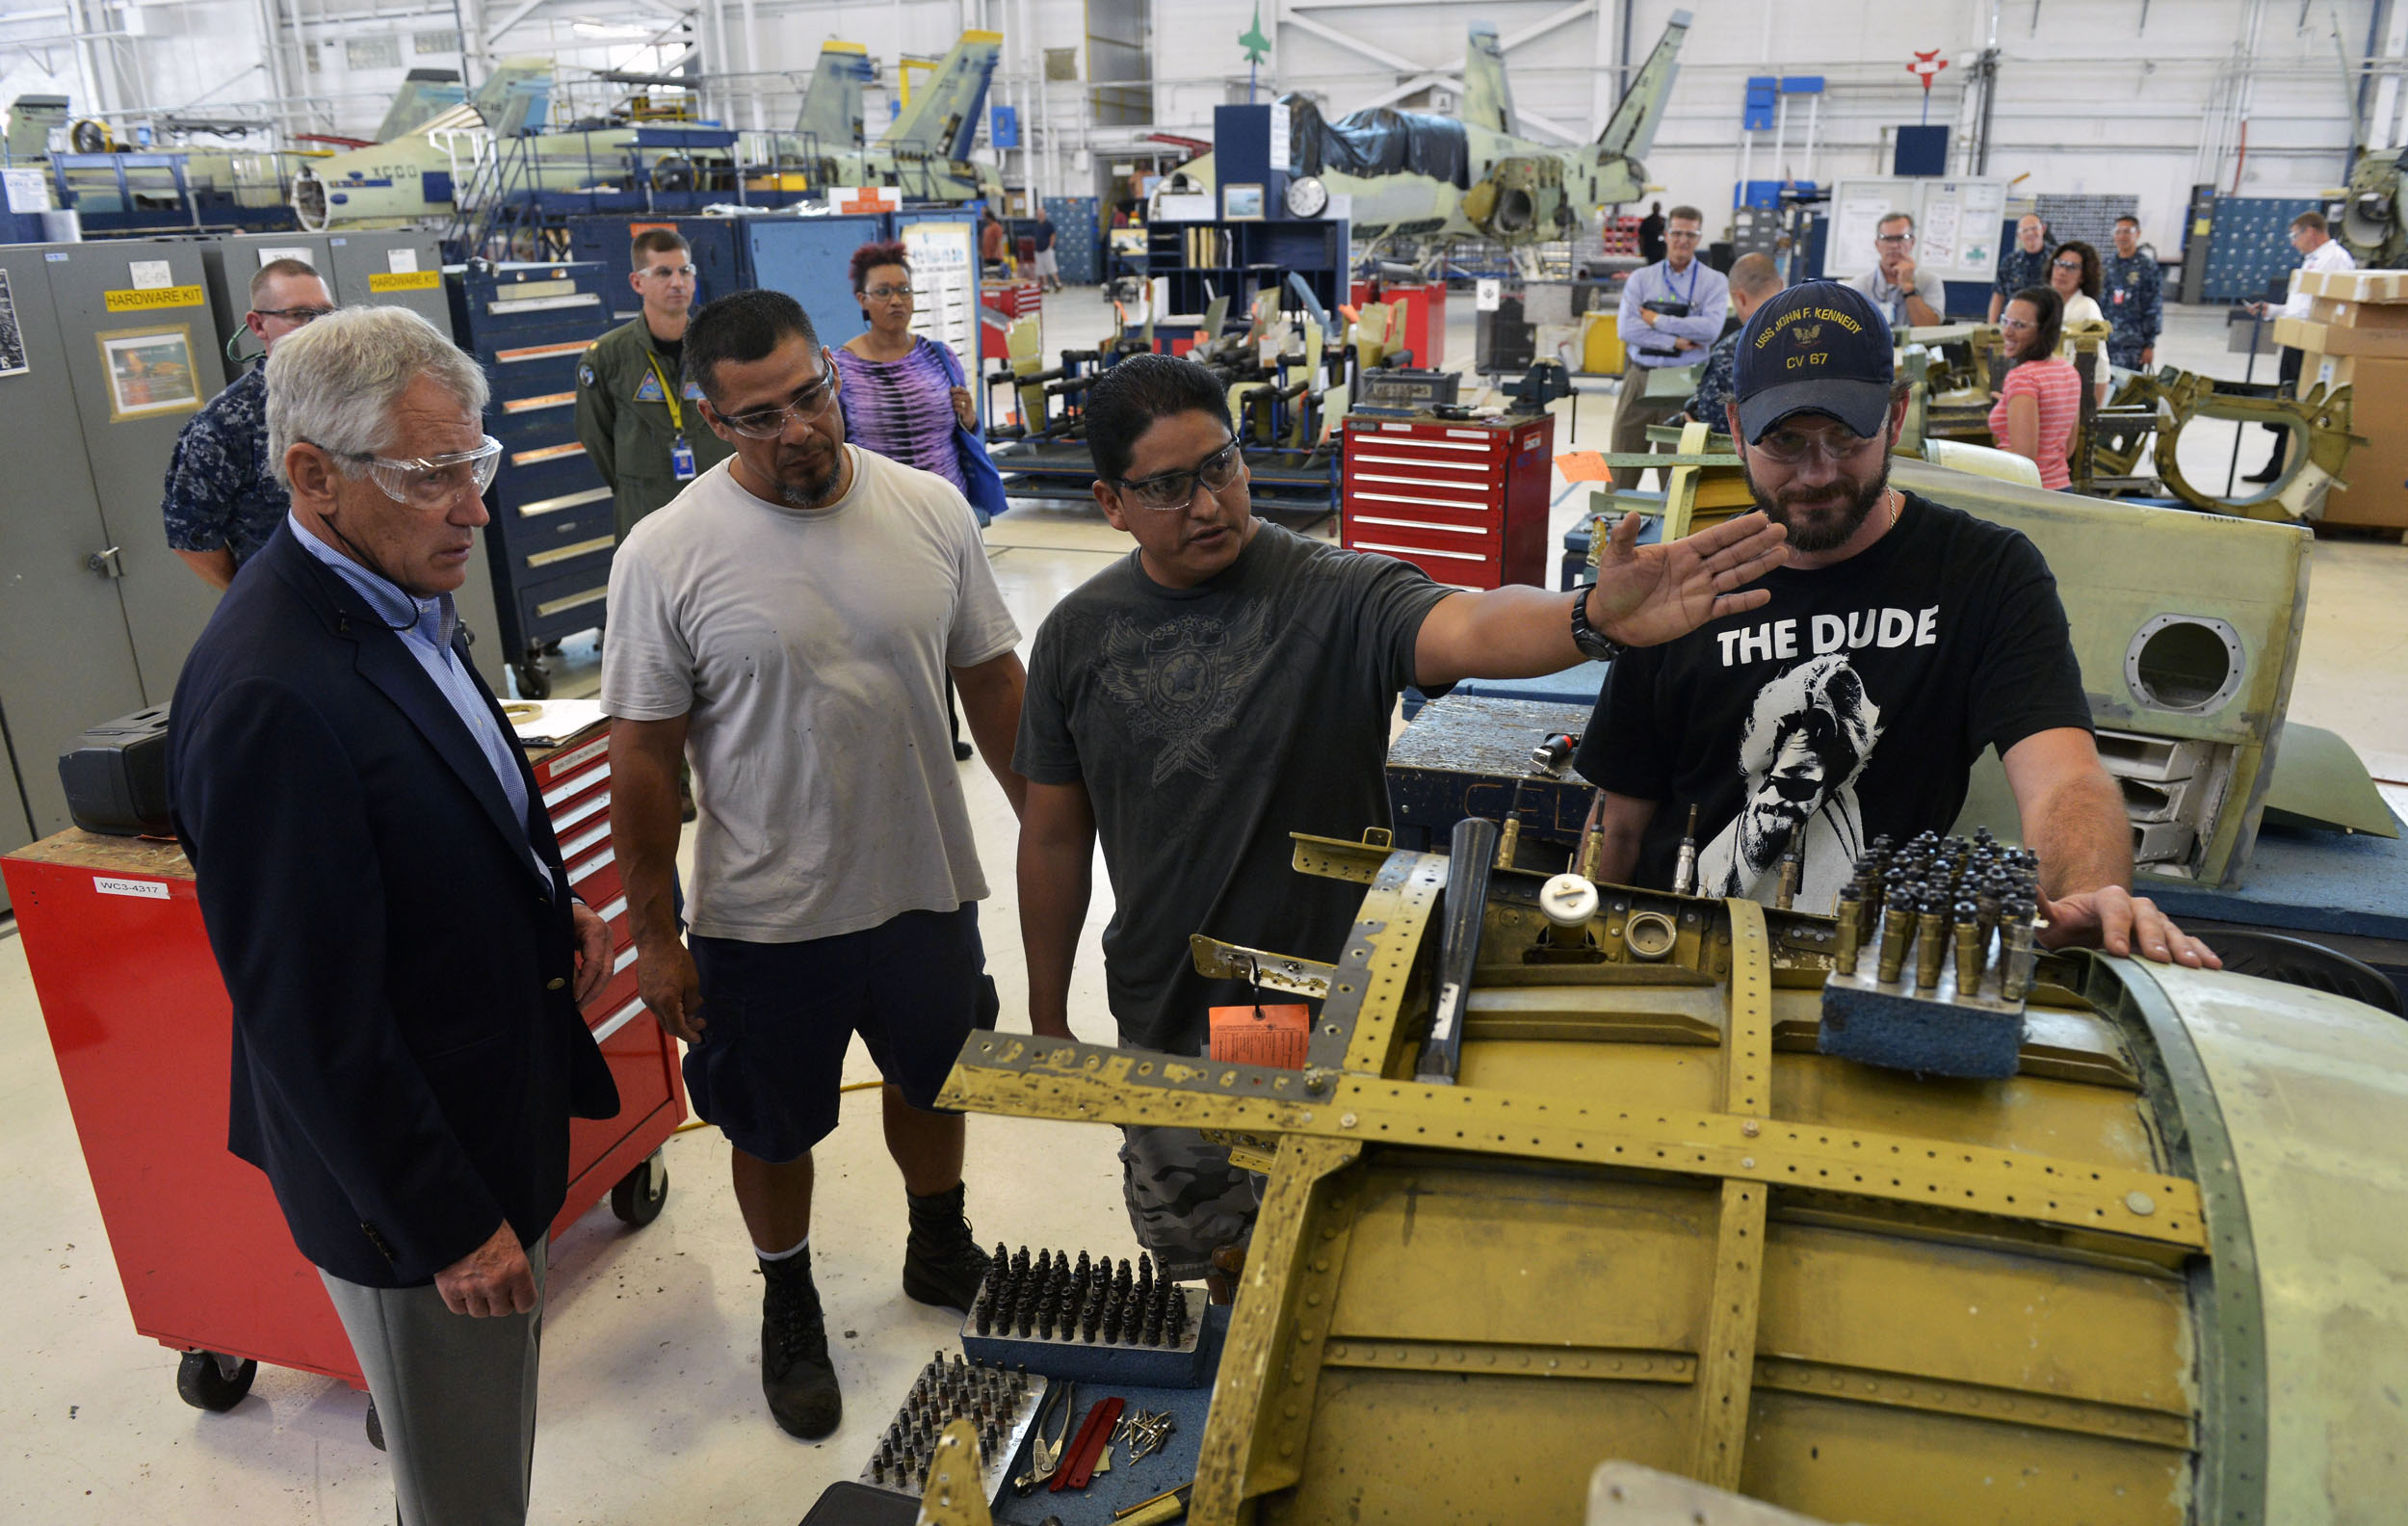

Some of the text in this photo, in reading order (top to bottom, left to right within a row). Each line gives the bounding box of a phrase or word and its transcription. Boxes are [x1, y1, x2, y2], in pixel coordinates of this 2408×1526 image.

[370, 272, 439, 288] HARDWARE KIT
[107, 288, 202, 306] HARDWARE KIT
[1755, 327, 1775, 350] USS
[1775, 308, 1801, 331] JOHN
[1815, 307, 1863, 334] KENNEDY
[1787, 353, 1828, 370] CV 67
[1716, 604, 1940, 668] THE DUDE
[100, 881, 158, 894] WC3-4317
